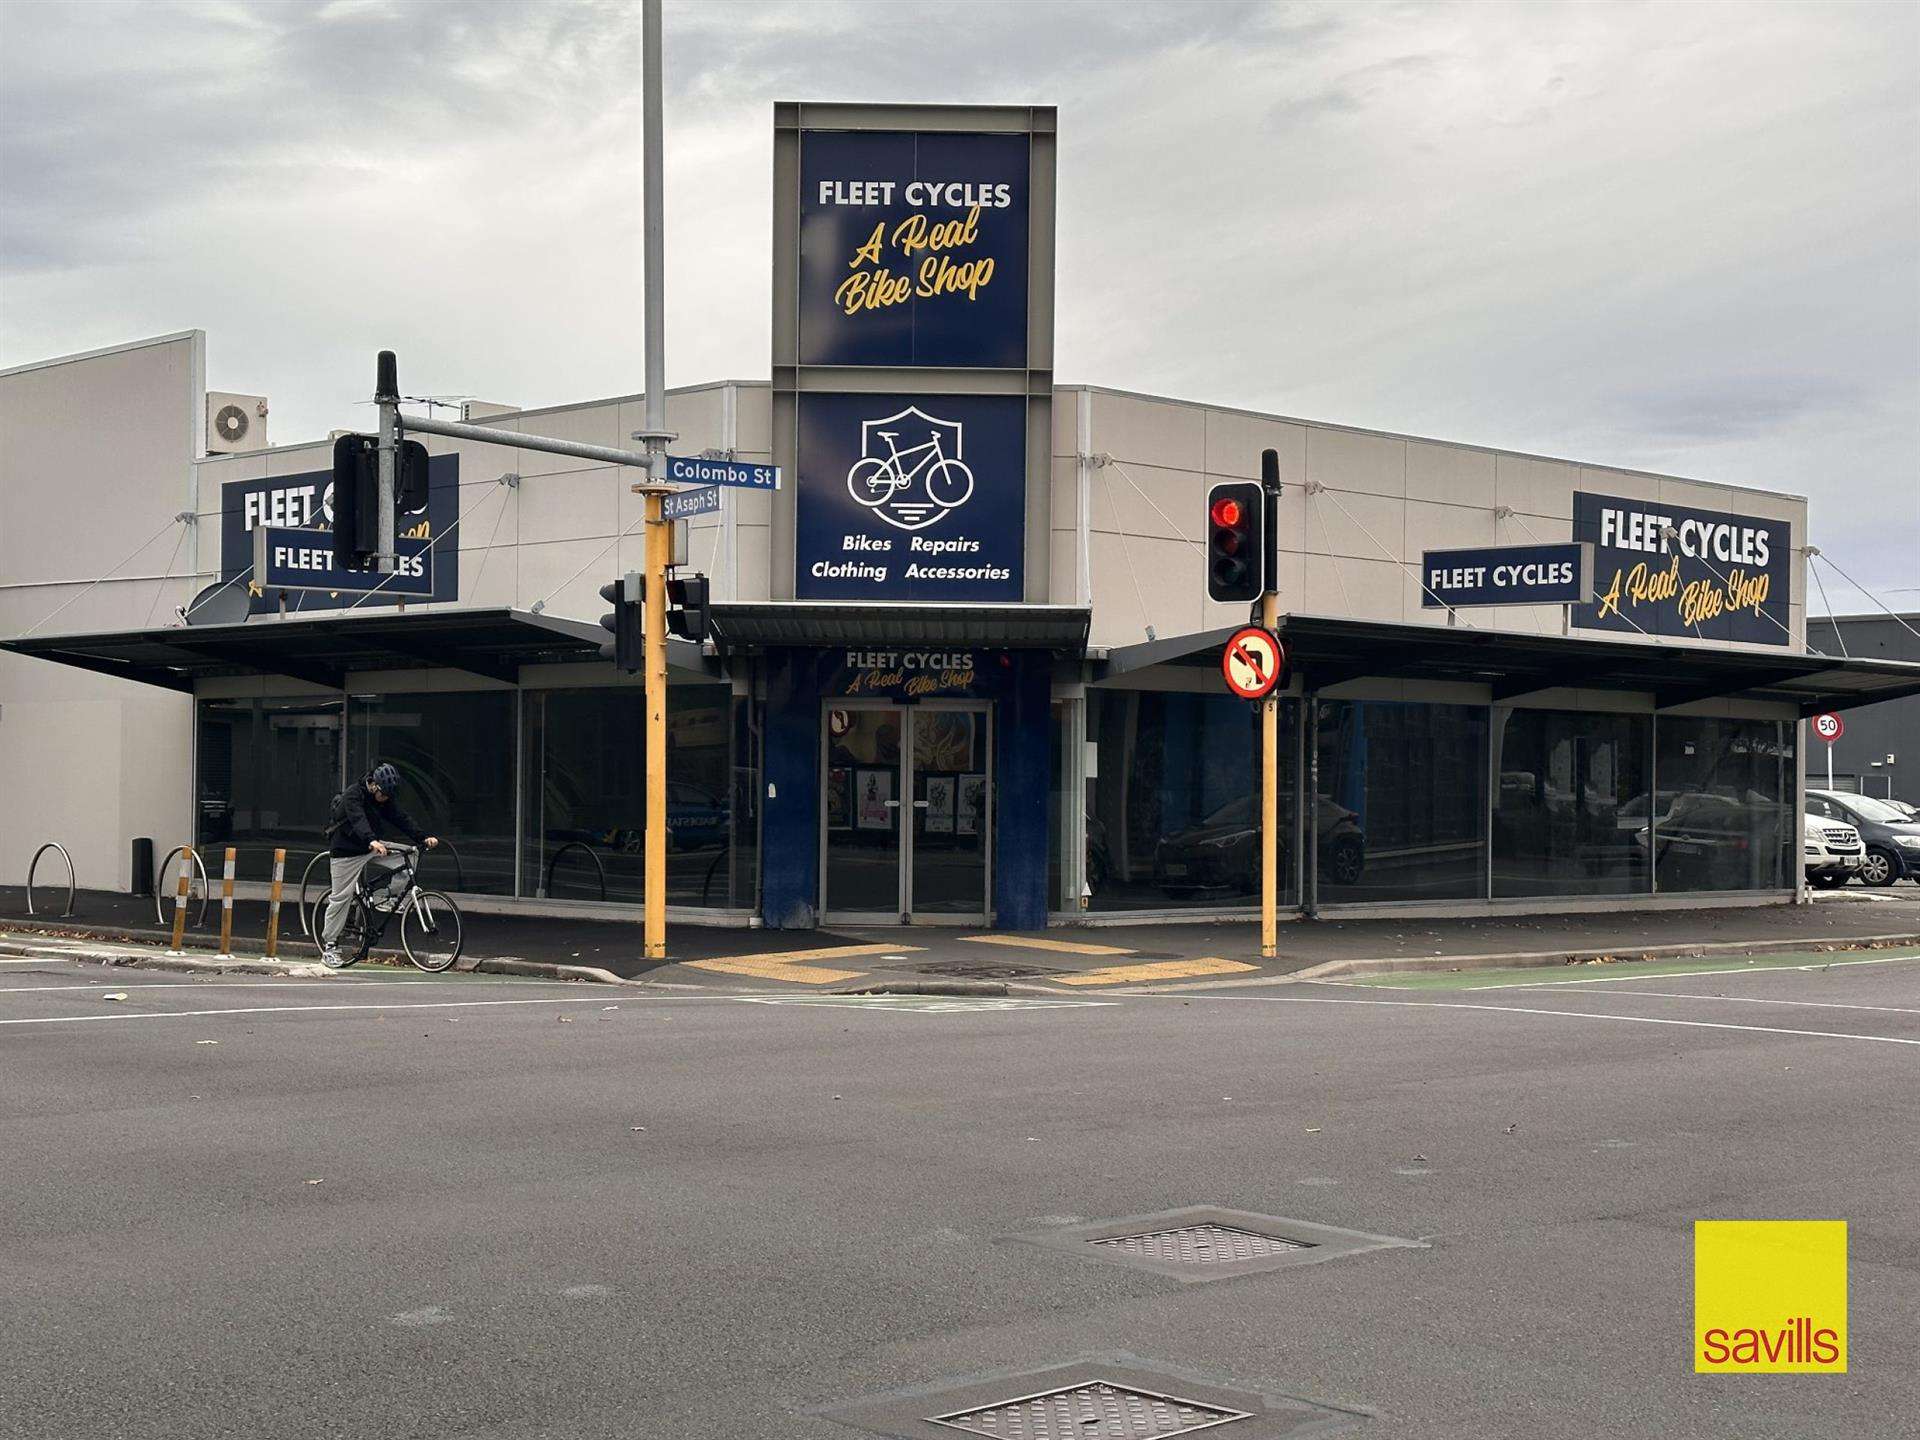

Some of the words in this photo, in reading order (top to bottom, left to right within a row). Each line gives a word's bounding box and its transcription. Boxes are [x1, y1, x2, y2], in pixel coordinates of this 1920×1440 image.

[819, 180, 896, 206] FLEET
[904, 181, 1011, 208] CYCLES
[849, 221, 886, 269] A
[892, 203, 980, 257] Real
[834, 268, 911, 316] Bike
[915, 255, 995, 301] Shop
[673, 461, 747, 483] Colombo
[753, 467, 771, 485] St
[244, 484, 316, 532] FLEET
[664, 500, 674, 515] St
[675, 494, 704, 513] Asaph
[706, 490, 717, 508] St
[842, 534, 892, 551] Bikes
[910, 536, 979, 555] Repairs
[1601, 508, 1673, 555] FLEET
[1678, 518, 1770, 568] CYCLES
[274, 546, 334, 572] FLEET
[811, 562, 887, 582] Clothing
[904, 563, 1010, 580] Accessories
[1430, 566, 1487, 590] FLEET
[1492, 562, 1574, 587] CYCLES
[1598, 568, 1623, 620] A
[1623, 555, 1679, 608] Real
[1678, 581, 1723, 628] Bike
[1725, 568, 1770, 618] Shop
[847, 652, 898, 668] FLEET
[903, 653, 973, 670] CYCLES
[845, 674, 862, 694] A
[864, 666, 904, 689] Real
[904, 675, 938, 696] Bike
[939, 669, 975, 690] Shop
[654, 713, 660, 722] 4
[1820, 719, 1836, 731] 50
